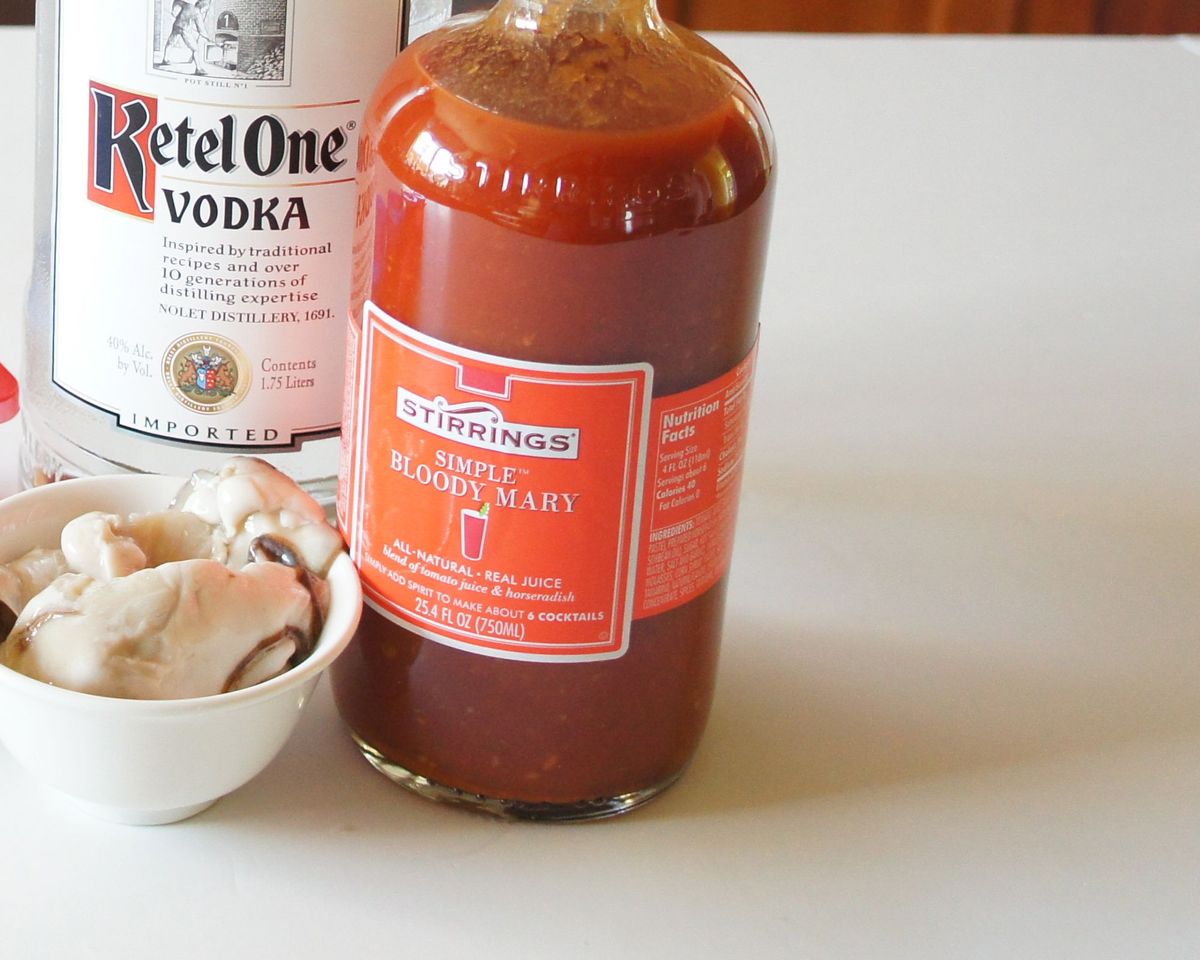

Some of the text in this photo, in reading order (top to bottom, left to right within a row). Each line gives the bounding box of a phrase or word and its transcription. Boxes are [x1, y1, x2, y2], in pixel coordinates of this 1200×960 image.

[184, 78, 201, 86] POT
[205, 80, 231, 89] STILL
[90, 88, 348, 213] Ketel One
[161, 188, 311, 231] VODKA
[163, 236, 332, 258] Inspired by traditional
[163, 254, 300, 273] recipes and over
[162, 268, 309, 288] 10 generations of
[160, 284, 319, 305] distilling expertise
[159, 303, 336, 324] NOLET DISTILLERY, 1691.
[106, 335, 153, 360] 40% Alc.
[117, 355, 153, 378] by Vol.
[261, 357, 317, 373] Contents
[260, 376, 314, 390] 1.75 Liters
[402, 397, 572, 452] STIRRINGS
[663, 399, 720, 429] Nutrition
[132, 413, 279, 441] IMPORTED
[661, 425, 696, 445] Facts
[659, 448, 685, 464] Serving
[435, 450, 517, 486] SIMPLE
[390, 448, 581, 513] BLOODY MARY
[657, 472, 685, 488] Servings
[656, 484, 686, 500] Calories
[382, 544, 576, 603] blend of tomato juice & horseradish
[392, 538, 562, 589] ALL-NATURAL REAL JUICE
[387, 570, 407, 586] ADD
[407, 580, 435, 598] SPIRIT
[436, 591, 451, 604] TO
[453, 597, 483, 614] MAKE
[485, 605, 525, 620] ABOUT
[527, 610, 535, 621] 6
[538, 610, 605, 622] COCKTAILS
[414, 596, 526, 641] 25.4 FL OZ (750ML)
